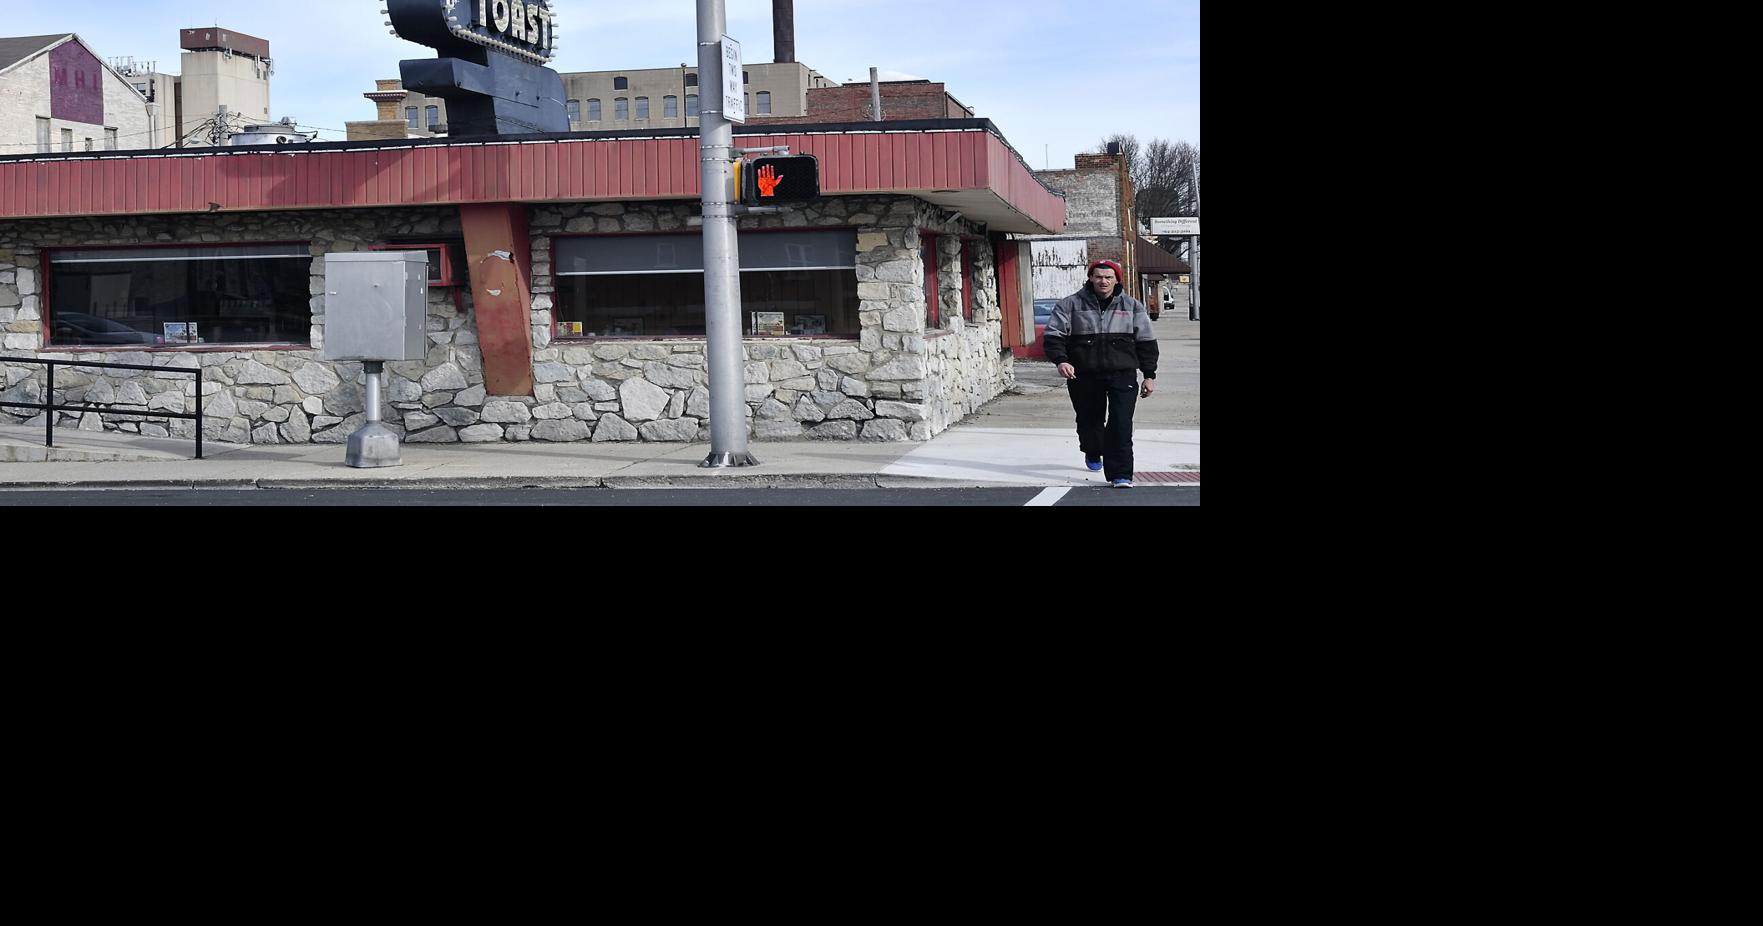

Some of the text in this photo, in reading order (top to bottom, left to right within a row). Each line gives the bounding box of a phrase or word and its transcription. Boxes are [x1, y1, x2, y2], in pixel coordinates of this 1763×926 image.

[479, 0, 550, 49] TOAST
[726, 46, 738, 61] BEGIN
[729, 63, 737, 77] TWO
[730, 80, 738, 94] WAY
[725, 95, 743, 112] TRAFFIC
